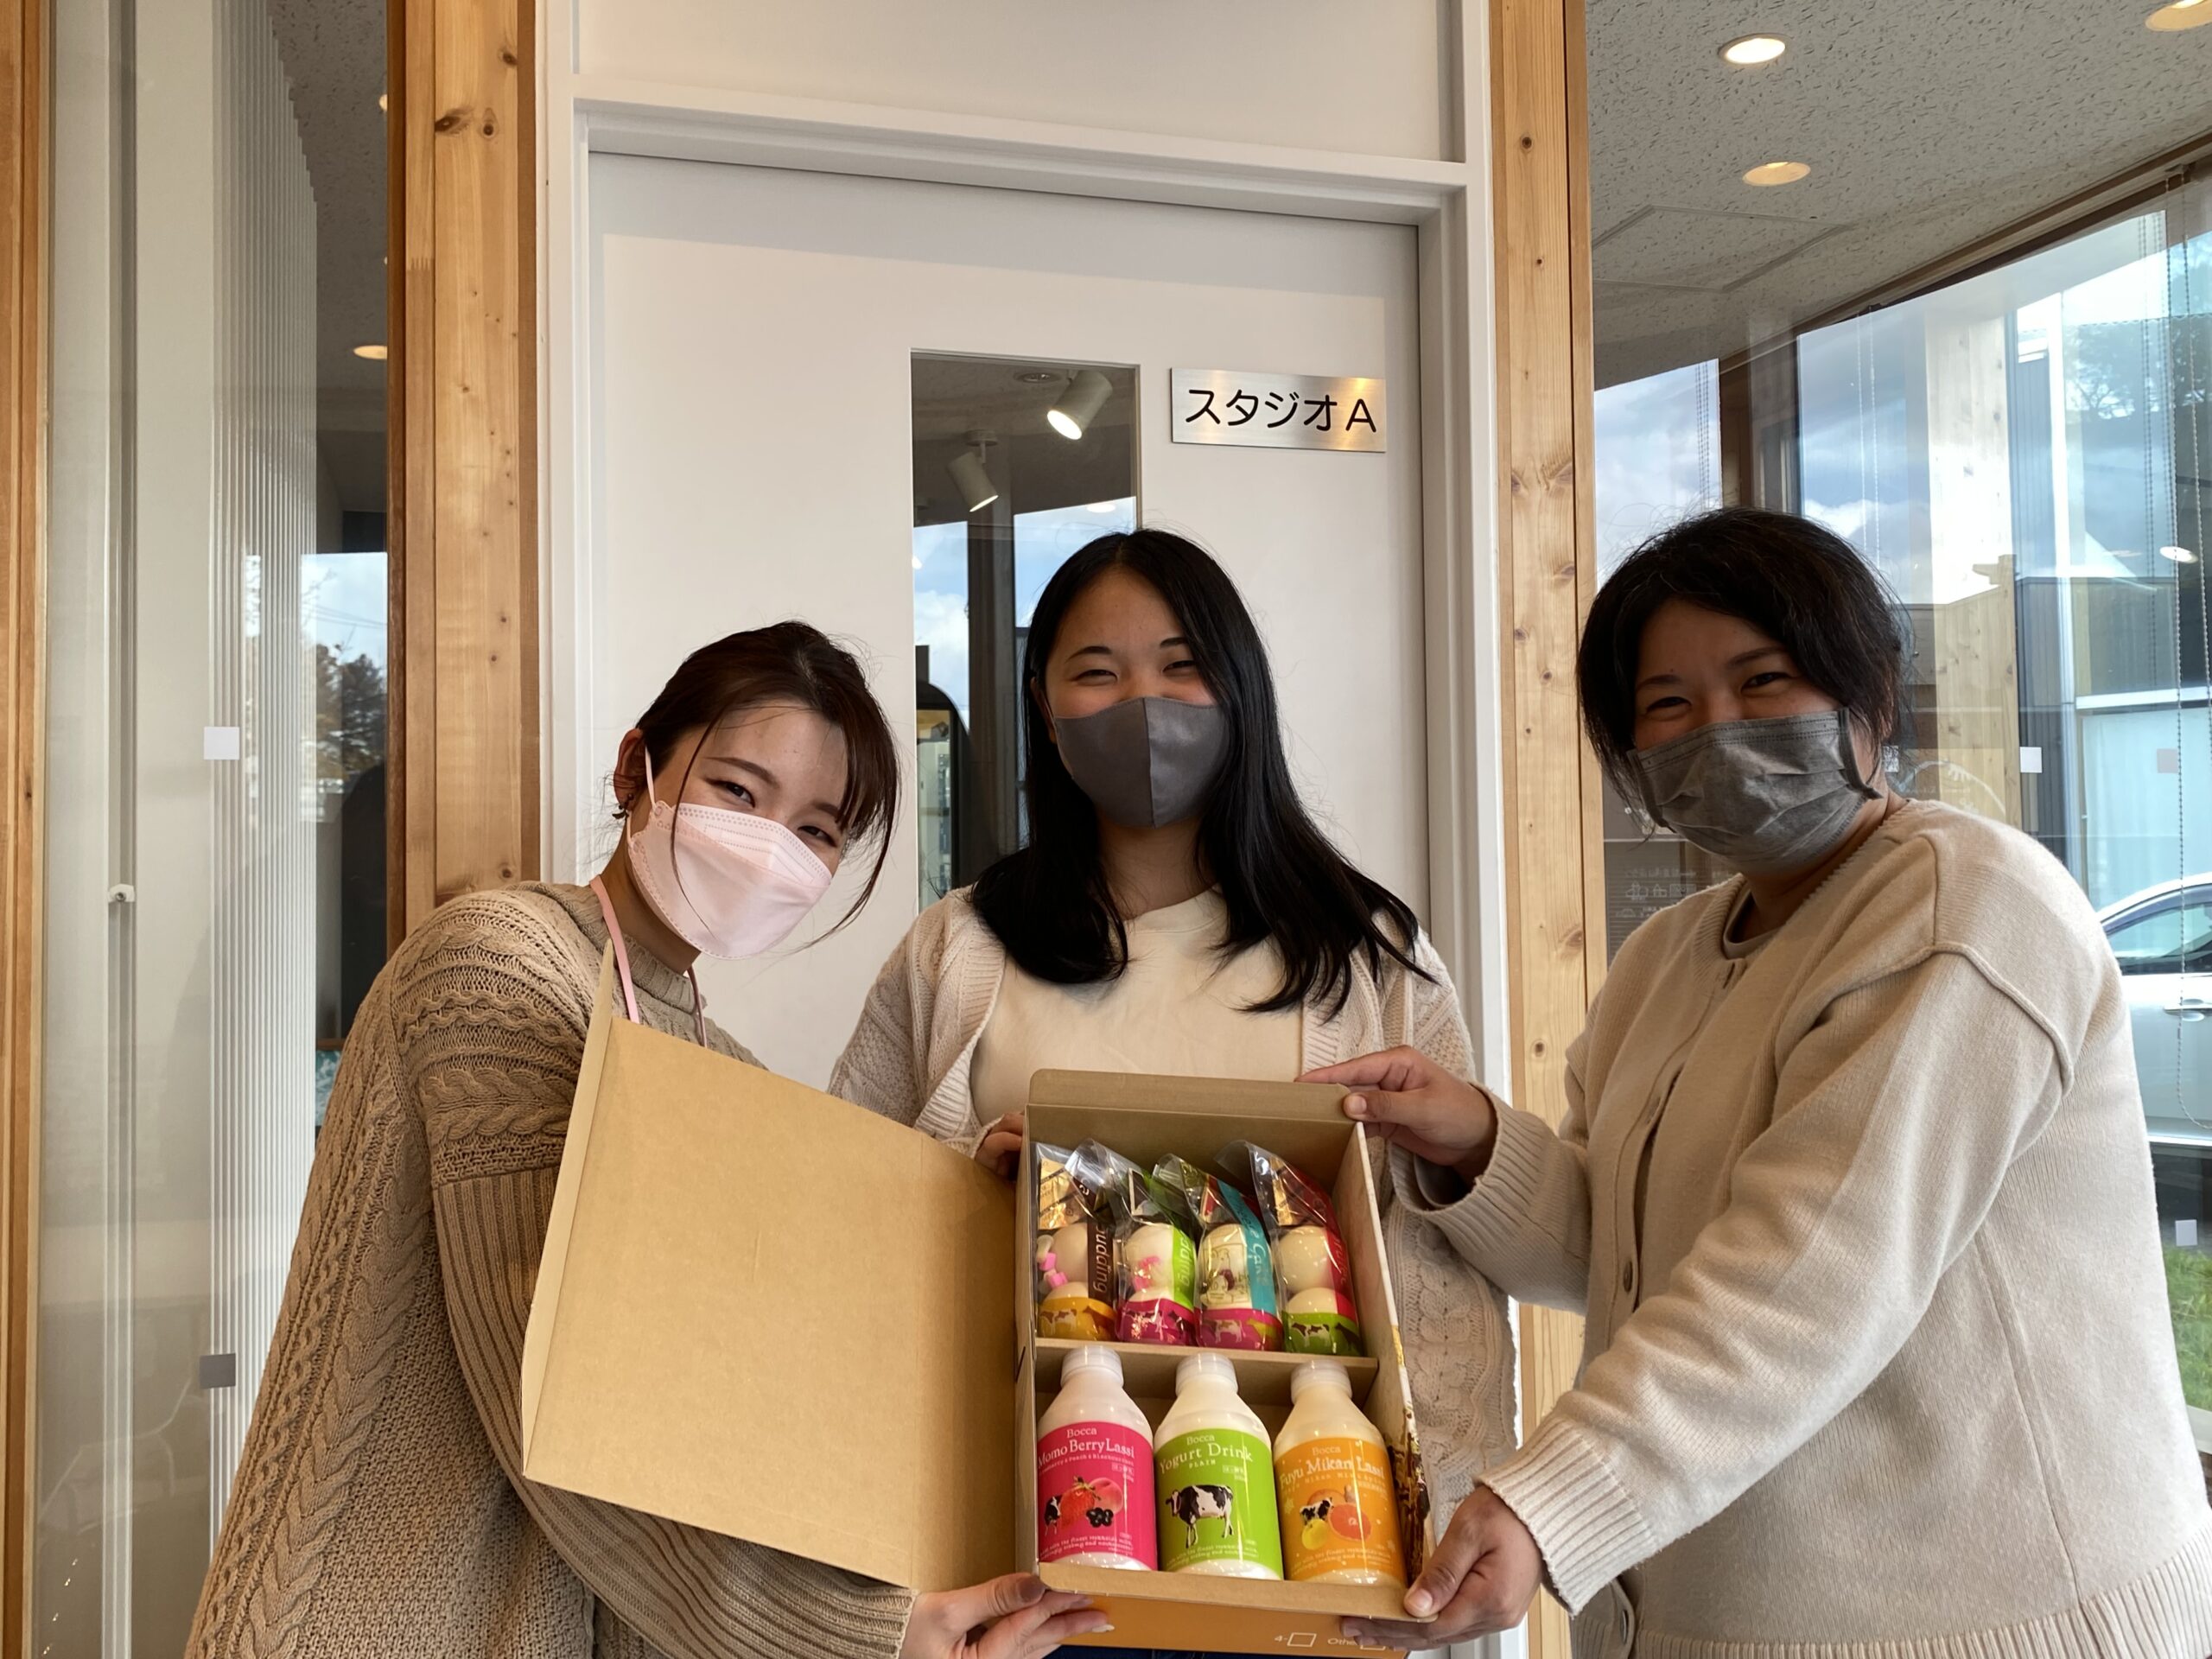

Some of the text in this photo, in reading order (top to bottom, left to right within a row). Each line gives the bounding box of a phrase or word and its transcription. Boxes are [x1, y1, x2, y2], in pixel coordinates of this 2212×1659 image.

[1066, 1427, 1097, 1439] Bocca
[1186, 1434, 1215, 1446] Bocca
[1038, 1446, 1068, 1469] Momo
[1069, 1439, 1105, 1453] Berry
[1105, 1438, 1135, 1459] Lassi
[1160, 1448, 1203, 1474] Yogurt
[1207, 1442, 1253, 1462] Drink
[1312, 1446, 1341, 1456] Bocca
[1306, 1457, 1354, 1475] Mikan
